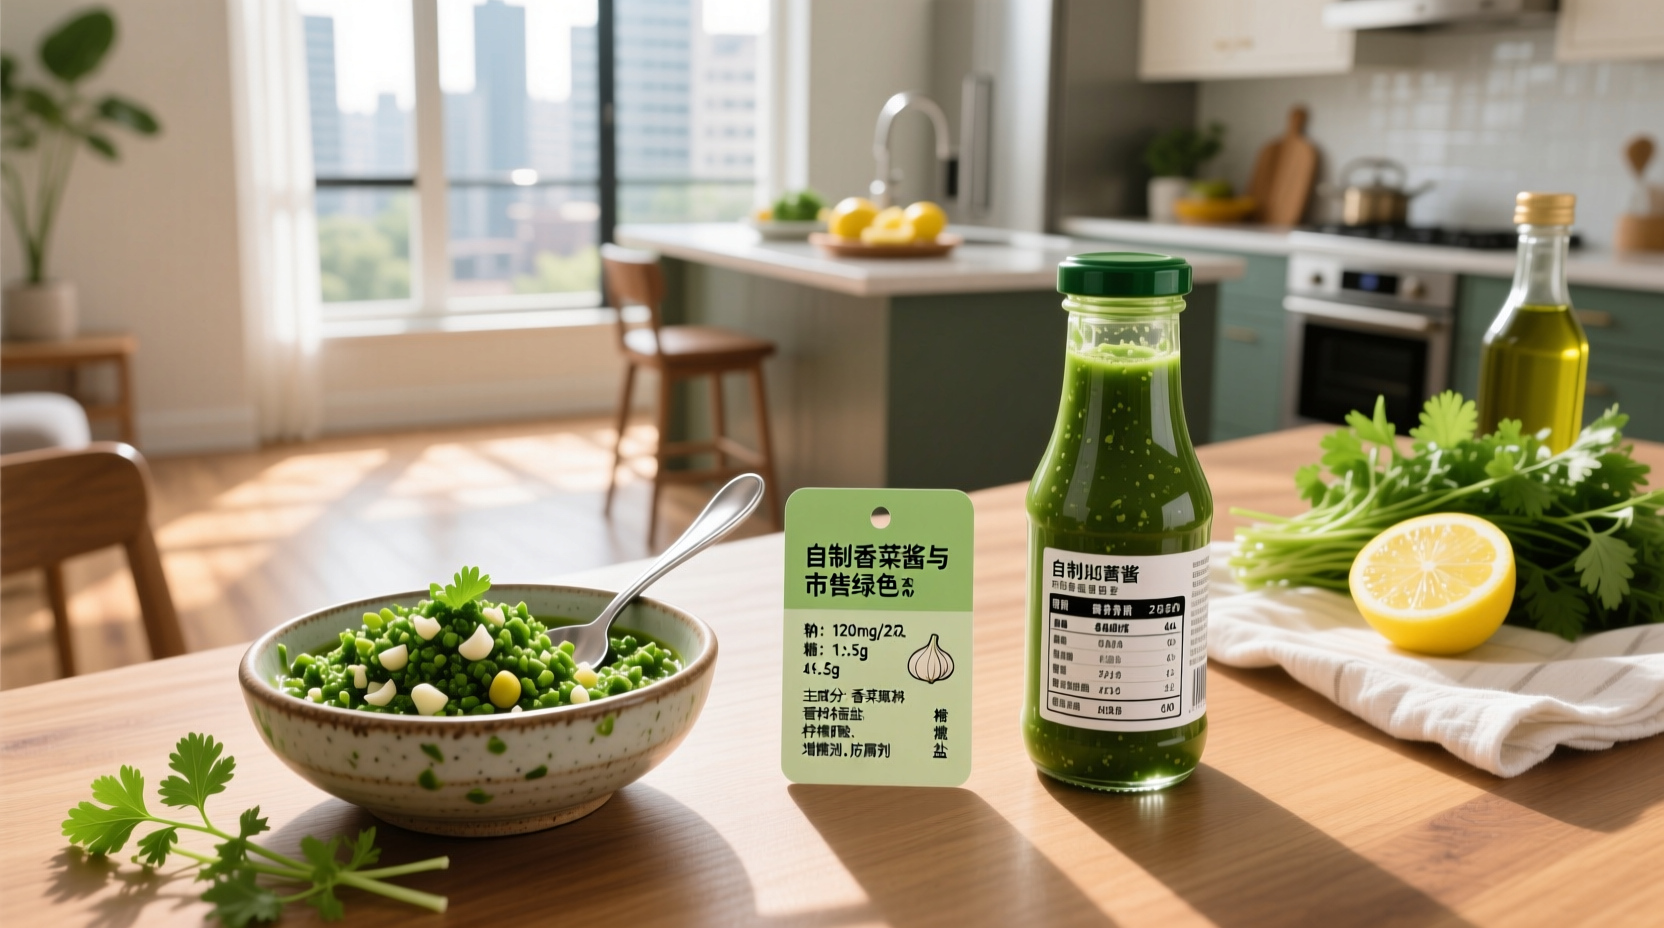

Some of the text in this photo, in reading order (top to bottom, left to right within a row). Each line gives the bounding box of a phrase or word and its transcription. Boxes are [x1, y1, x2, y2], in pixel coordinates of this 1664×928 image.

[807, 543, 949, 570] 自制香菜酱与
